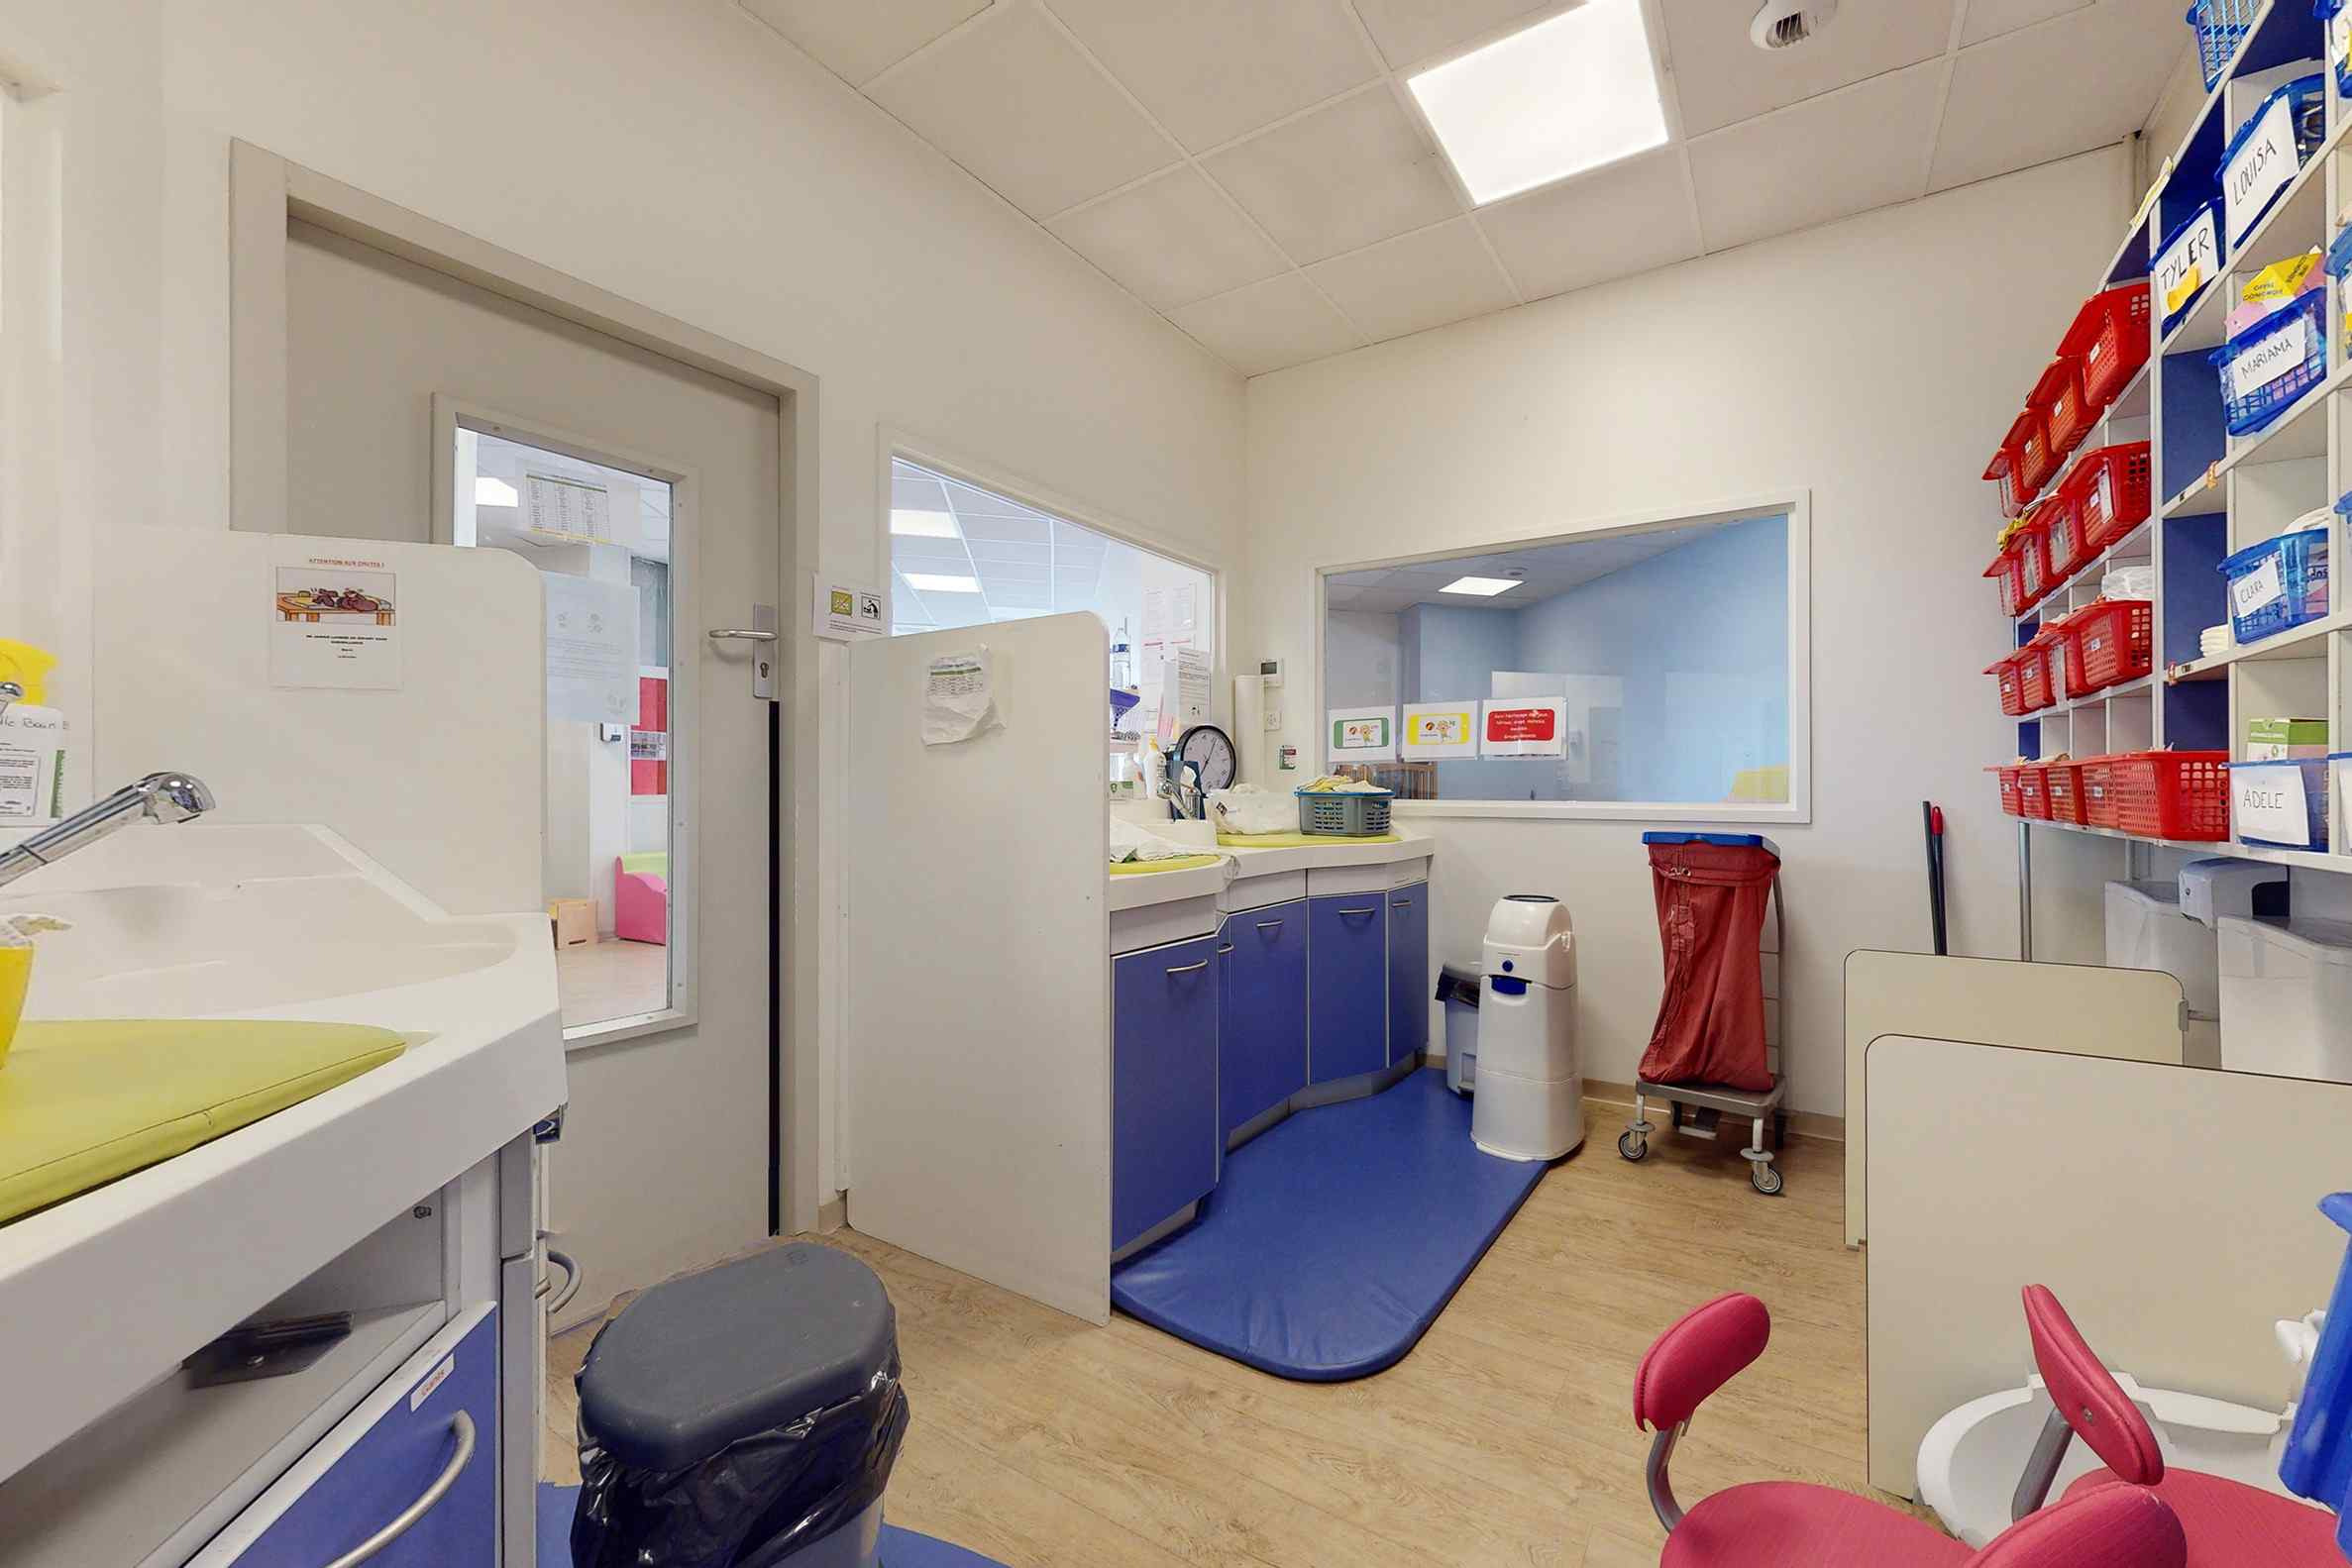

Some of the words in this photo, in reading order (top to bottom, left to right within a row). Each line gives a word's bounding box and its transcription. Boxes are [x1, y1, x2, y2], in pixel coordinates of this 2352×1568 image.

[2232, 138, 2278, 206] LOUISA
[2160, 227, 2210, 290] TYLER
[2241, 338, 2293, 379] MARIAMA
[2240, 579, 2265, 604] CLARA
